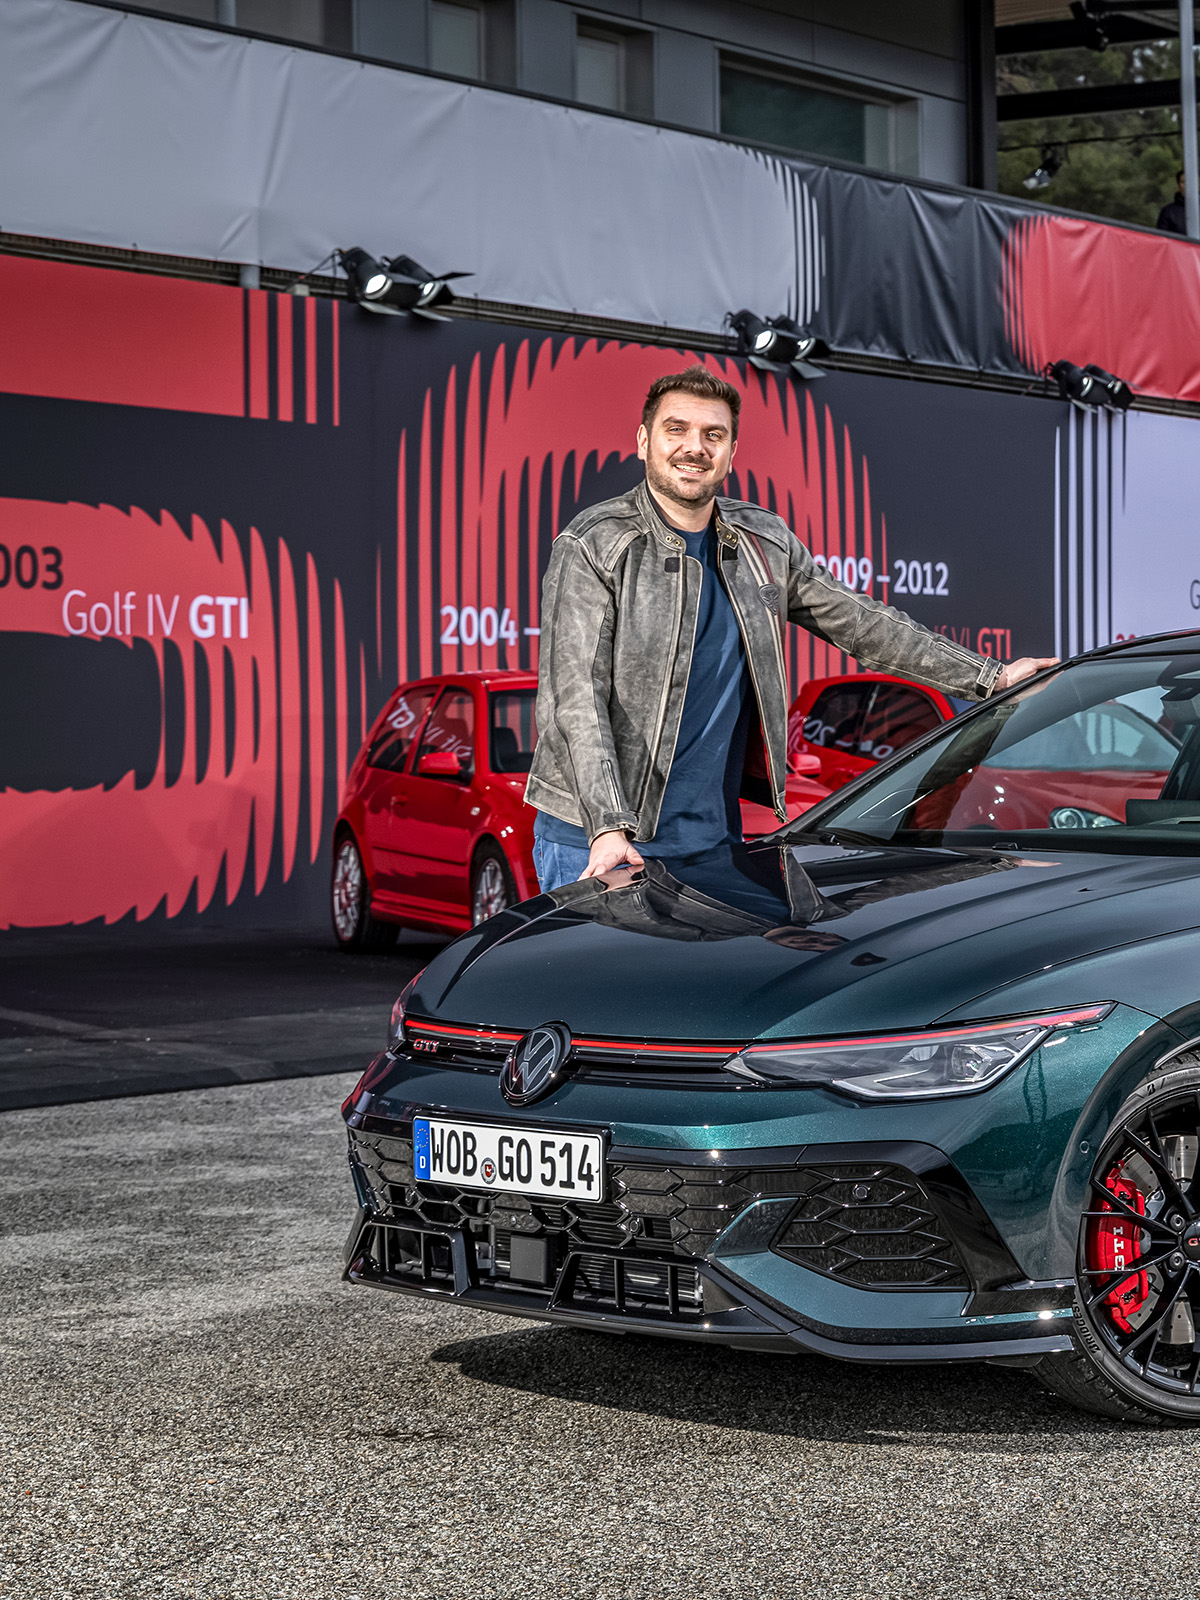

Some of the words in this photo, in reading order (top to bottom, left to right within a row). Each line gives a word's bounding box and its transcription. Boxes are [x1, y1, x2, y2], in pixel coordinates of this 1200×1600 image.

[893, 559, 949, 596] 2012
[62, 589, 136, 636] Golf
[147, 593, 180, 636] IV
[189, 594, 249, 639] GTI
[440, 604, 519, 647] 2004
[977, 626, 1012, 661] GTI
[413, 1038, 440, 1053] GTI
[419, 1156, 426, 1169] D
[430, 1127, 477, 1176] WOB
[498, 1135, 532, 1183] GO
[540, 1140, 595, 1191] 514
[1113, 1226, 1125, 1271] GTI
